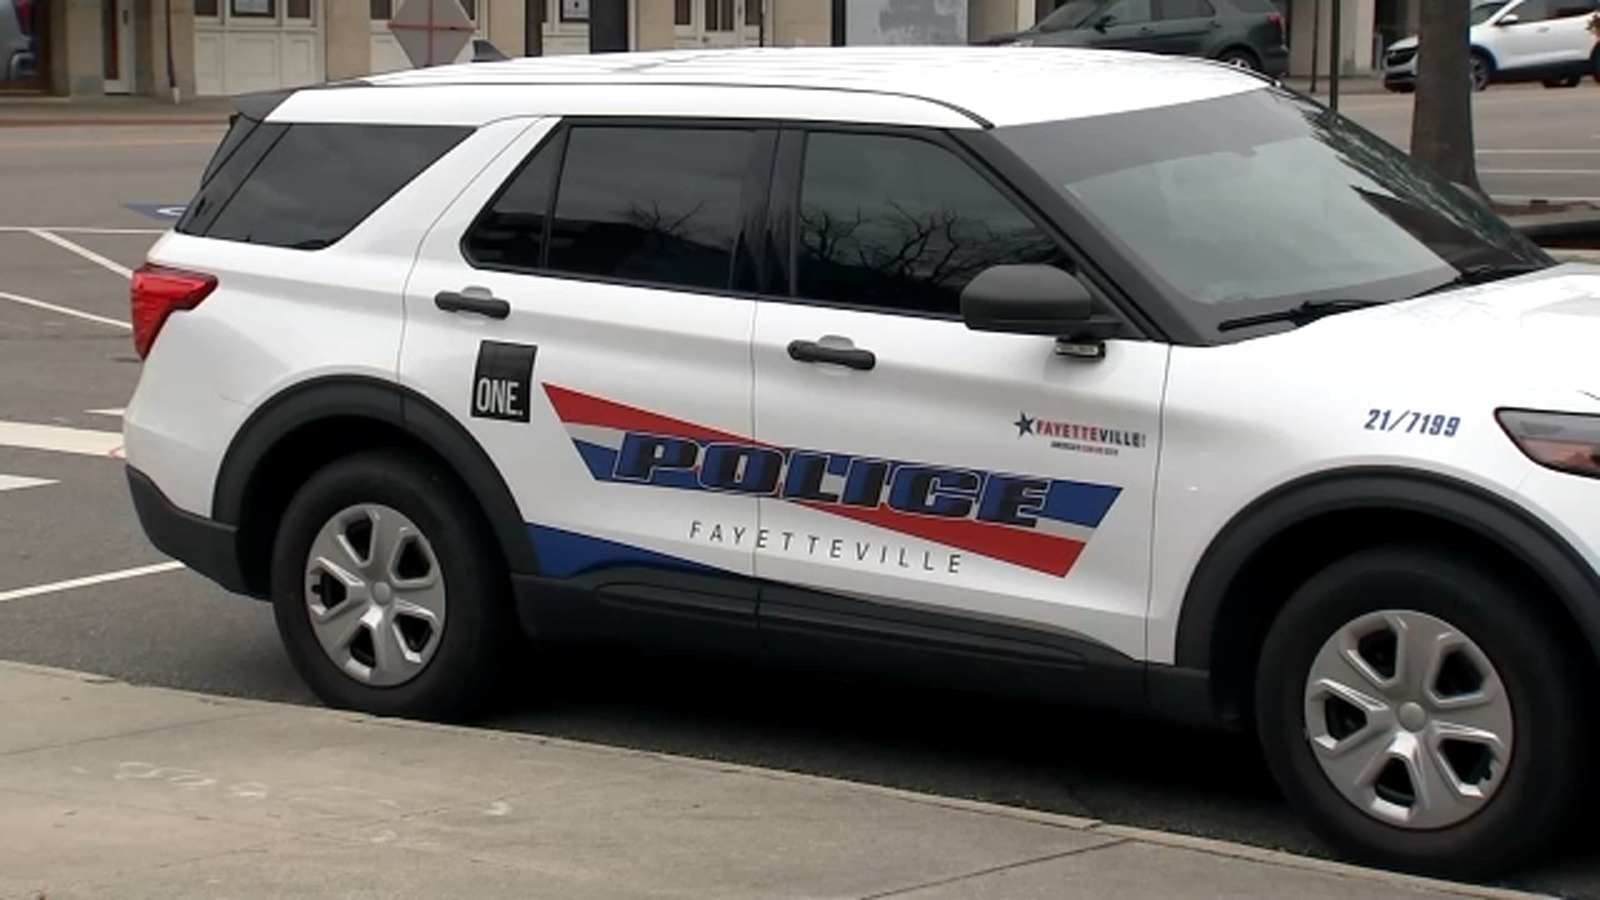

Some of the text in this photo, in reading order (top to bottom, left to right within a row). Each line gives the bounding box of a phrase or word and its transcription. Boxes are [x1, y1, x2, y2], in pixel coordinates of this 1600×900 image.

[476, 378, 523, 416] ONE.
[1364, 409, 1461, 437] 21/7199
[613, 432, 1053, 527] POLICE
[689, 520, 965, 574] FAYETTEVILLE
